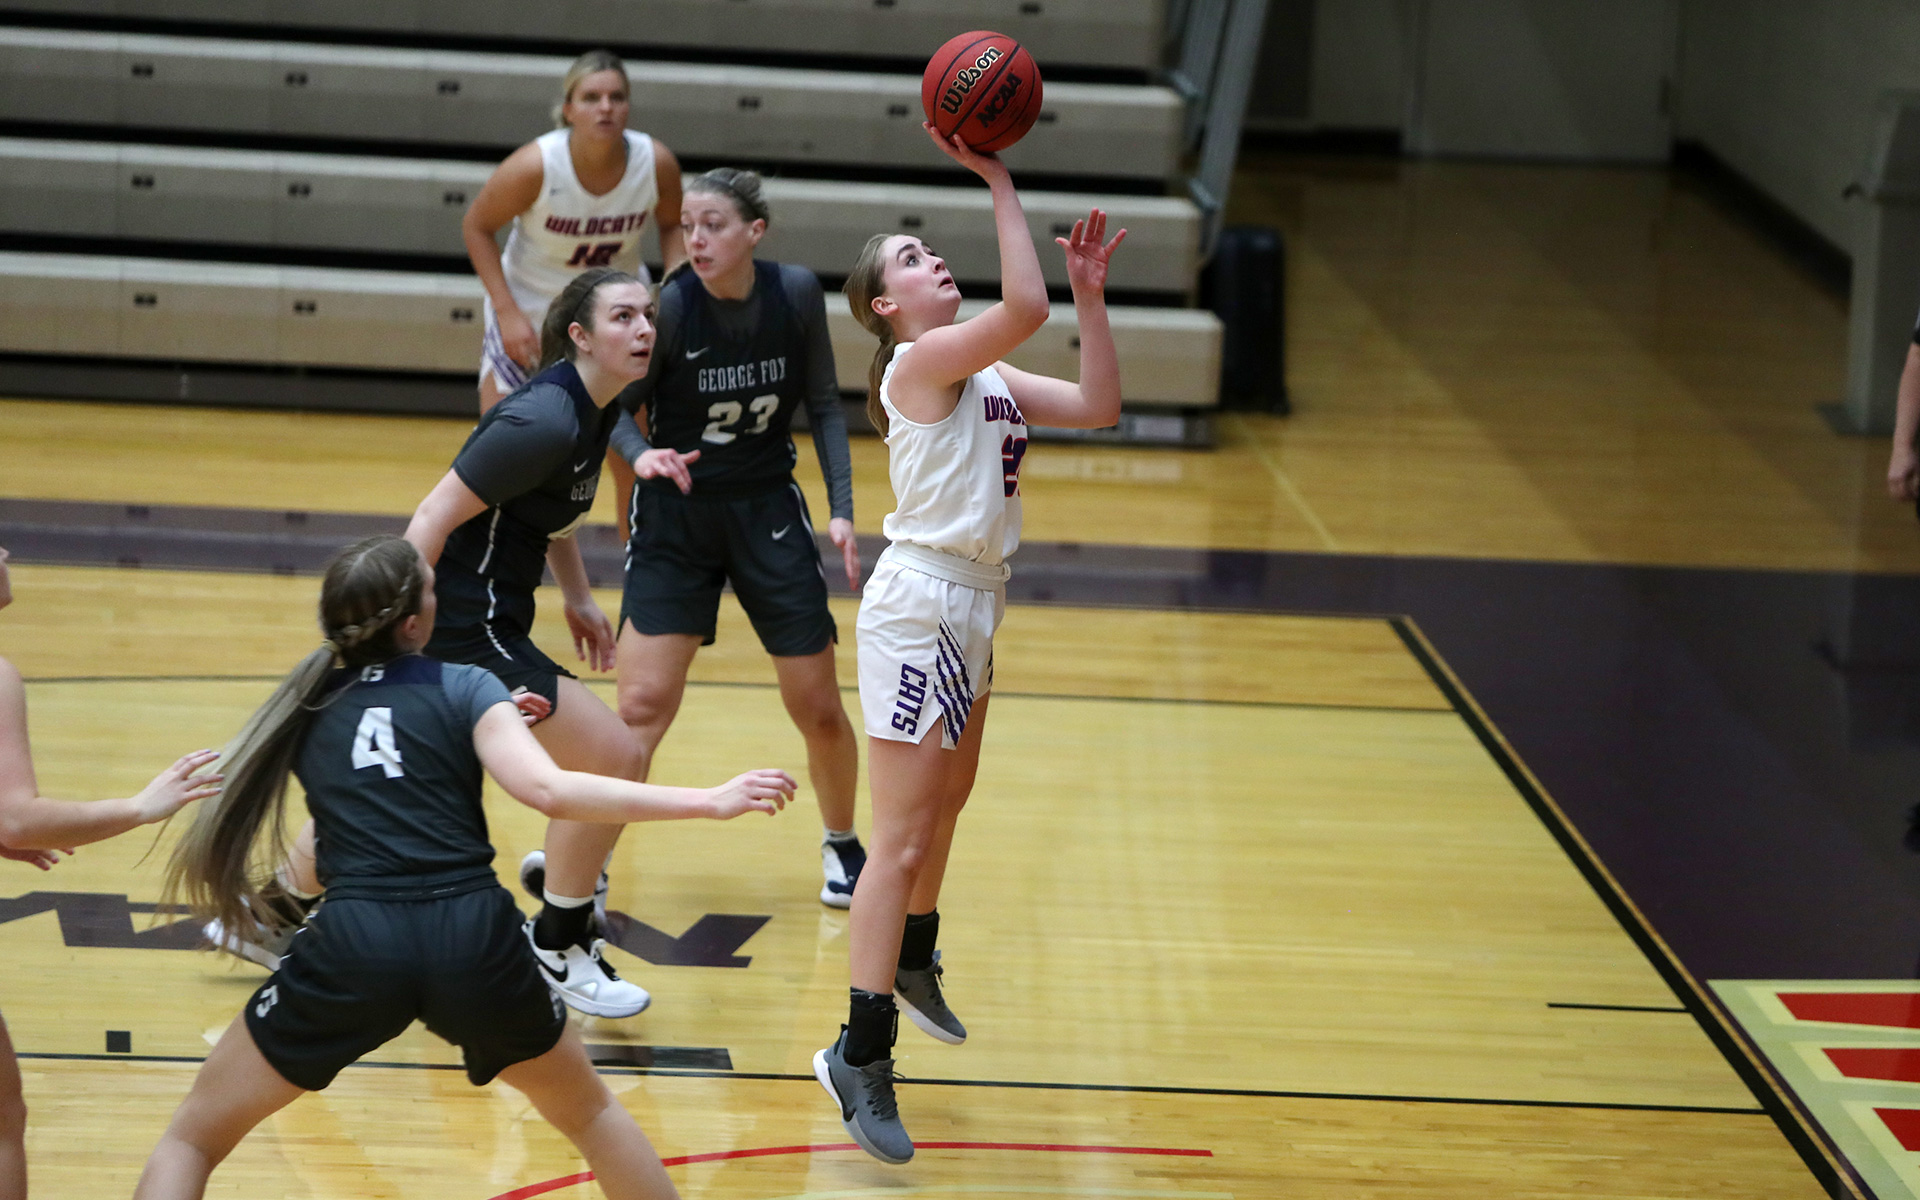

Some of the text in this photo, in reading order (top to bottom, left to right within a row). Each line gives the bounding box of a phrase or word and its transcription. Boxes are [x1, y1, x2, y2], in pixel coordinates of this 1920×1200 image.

[940, 46, 1004, 115] Wilson
[976, 72, 1022, 128] NCAA
[545, 210, 648, 236] WILDCATS
[698, 363, 756, 392] GEORGE
[701, 393, 779, 445] 23
[891, 663, 927, 736] CATS
[351, 706, 405, 779] 4
